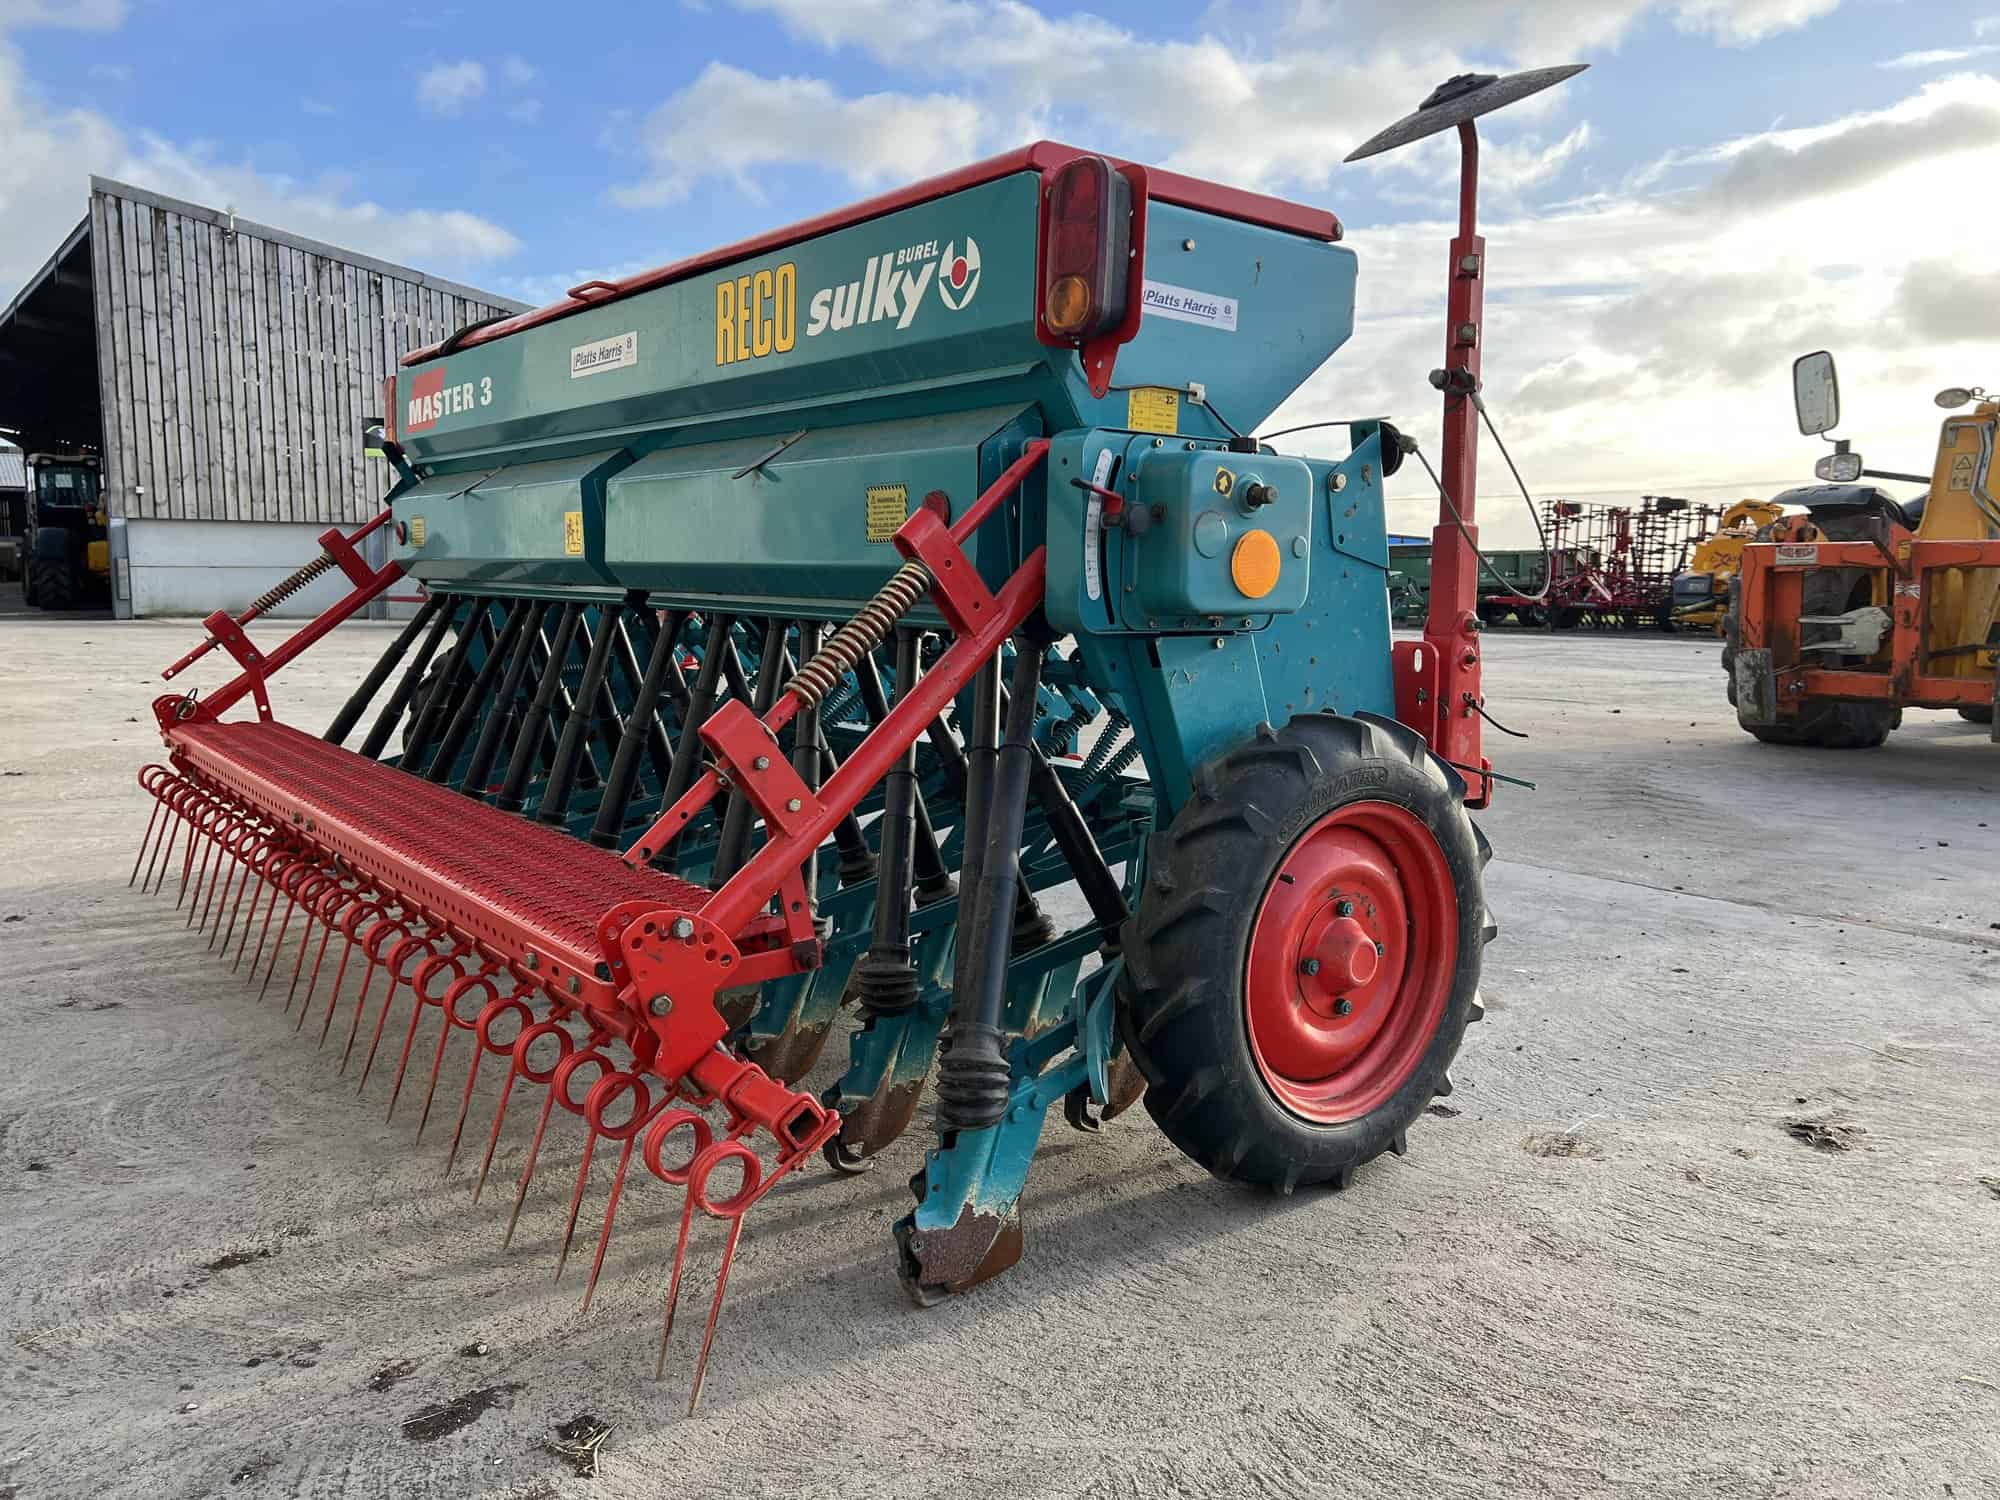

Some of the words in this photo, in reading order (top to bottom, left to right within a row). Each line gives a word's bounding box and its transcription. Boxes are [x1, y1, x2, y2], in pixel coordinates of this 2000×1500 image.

[897, 239, 939, 266] BUREL
[715, 260, 798, 368] RECO
[806, 252, 937, 337] sulky
[1145, 289, 1181, 308] Platts
[1182, 297, 1218, 316] Harris
[575, 349, 598, 368] Platts
[598, 342, 624, 362] Harris
[408, 382, 475, 426] MASTER
[480, 375, 493, 406] 3
